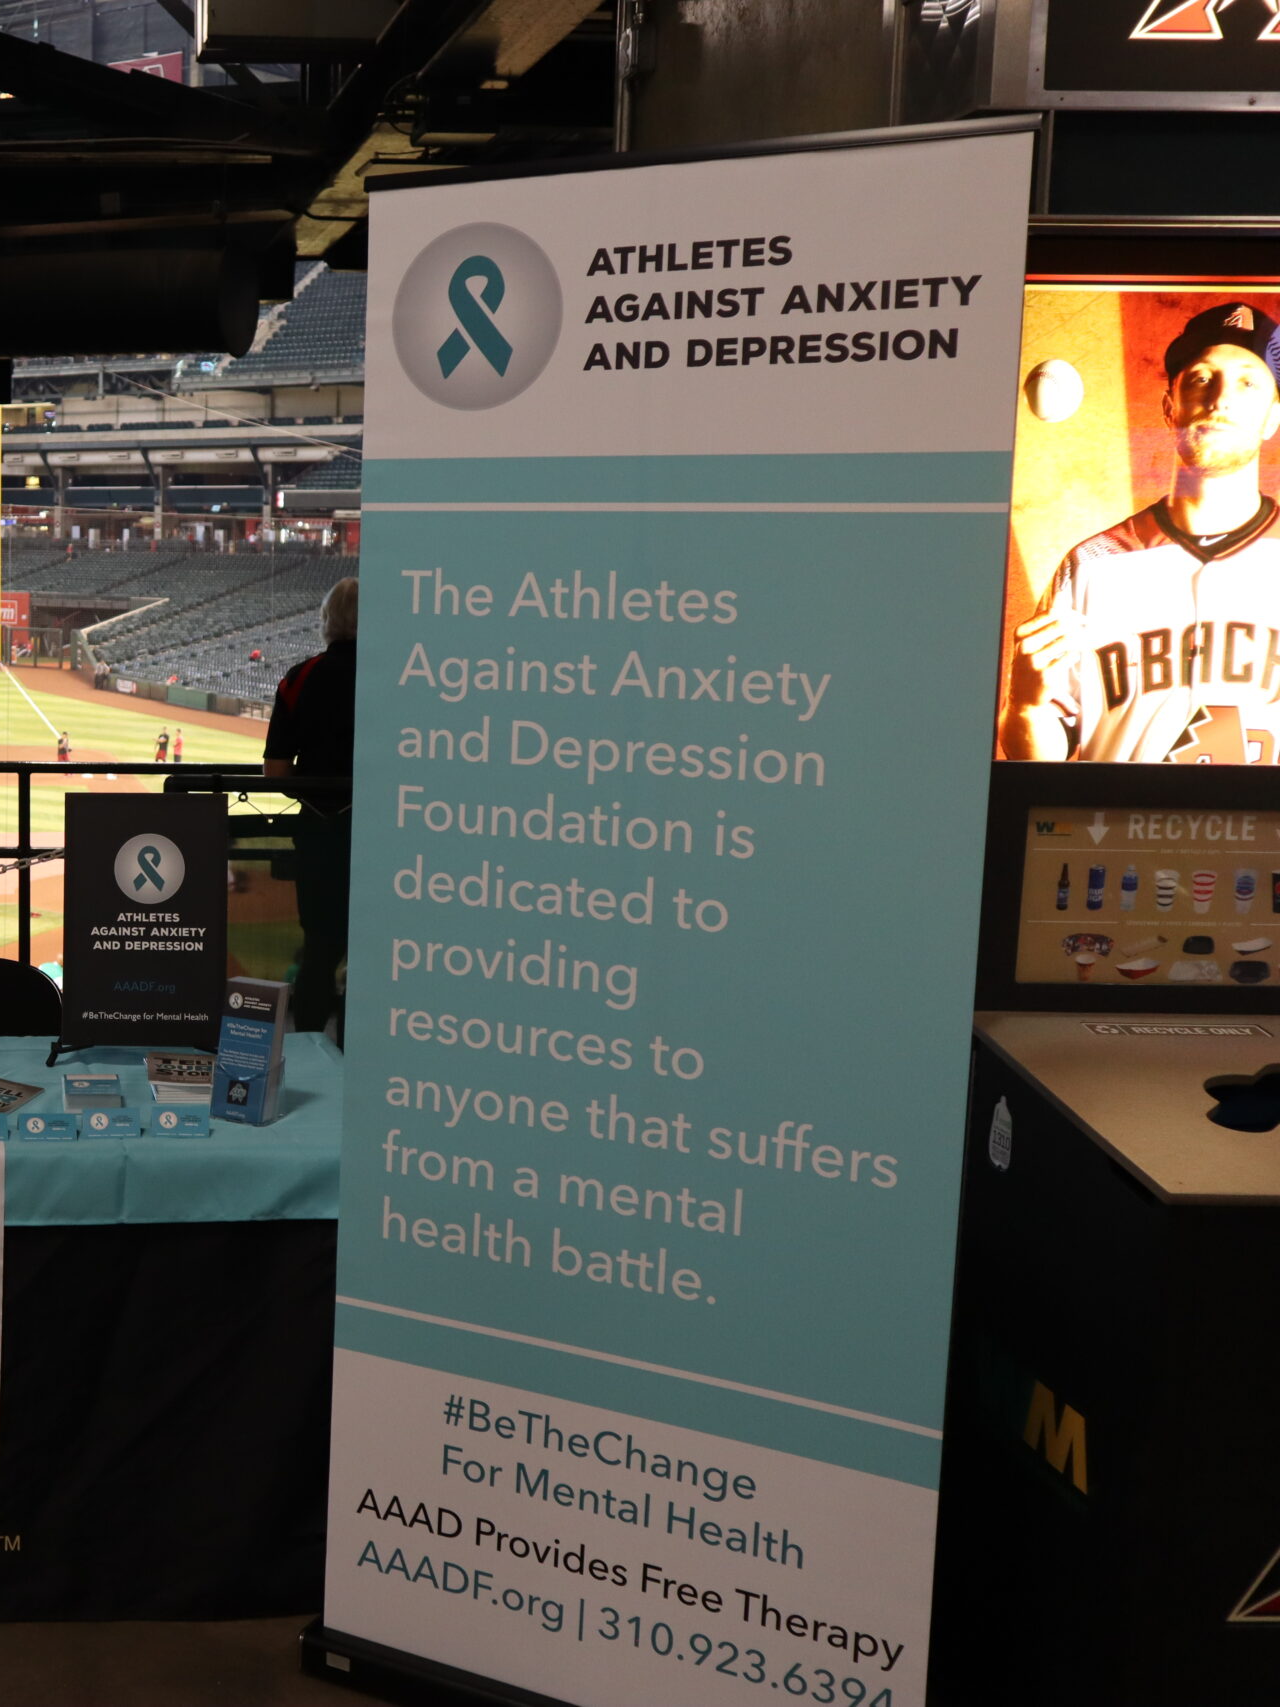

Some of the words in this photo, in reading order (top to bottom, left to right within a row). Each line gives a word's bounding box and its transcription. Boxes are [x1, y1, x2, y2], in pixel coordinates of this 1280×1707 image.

[587, 235, 793, 277] ATHLETES
[585, 287, 765, 324] AGAINST
[781, 275, 982, 315] ANXIETY
[583, 340, 670, 371] AND
[686, 328, 959, 367] DEPRESSION
[401, 568, 493, 617] The
[509, 570, 738, 624] Athletes
[398, 643, 597, 702] Against
[611, 651, 831, 721] Anxiety
[397, 716, 490, 763] and
[510, 720, 825, 787] Depression
[397, 785, 692, 853] Foundation
[715, 810, 755, 859] is
[1128, 814, 1257, 841] RECYCLE
[117, 912, 180, 923] ATHLETES
[394, 855, 654, 925] dedicated
[673, 888, 728, 932] to
[91, 926, 146, 937] AGAINST
[150, 927, 206, 937] ANXIETY
[93, 941, 120, 951] AND
[125, 941, 203, 951] DEPRESSION
[114, 981, 176, 994] AAADF.org
[392, 938, 638, 1010] providing
[82, 1011, 141, 1022] #BeTheChange
[143, 1012, 154, 1020] for
[156, 1012, 182, 1021] Mental
[184, 1012, 209, 1021] Health
[390, 1007, 632, 1070] resources
[649, 1036, 704, 1080] to
[1131, 1023, 1209, 1035] RECYCLE
[1210, 1026, 1254, 1036] ONLY
[156, 1068, 210, 1077] STOR
[385, 1076, 568, 1132] anyone
[586, 1094, 692, 1154] that
[708, 1121, 898, 1188] suffers
[382, 1130, 495, 1191] from
[514, 1167, 539, 1198] a
[560, 1174, 743, 1236] mental
[382, 1196, 532, 1267] health
[552, 1228, 716, 1304] battle.
[443, 1394, 757, 1503] #BeTheChange
[442, 1444, 502, 1488] For
[515, 1462, 651, 1529] Mental
[667, 1501, 805, 1569] Health
[356, 1488, 463, 1539] AAAD
[475, 1517, 627, 1586] Provides
[641, 1563, 723, 1613] Free
[735, 1588, 905, 1672] Therapy
[357, 1540, 565, 1633] AAADF.org
